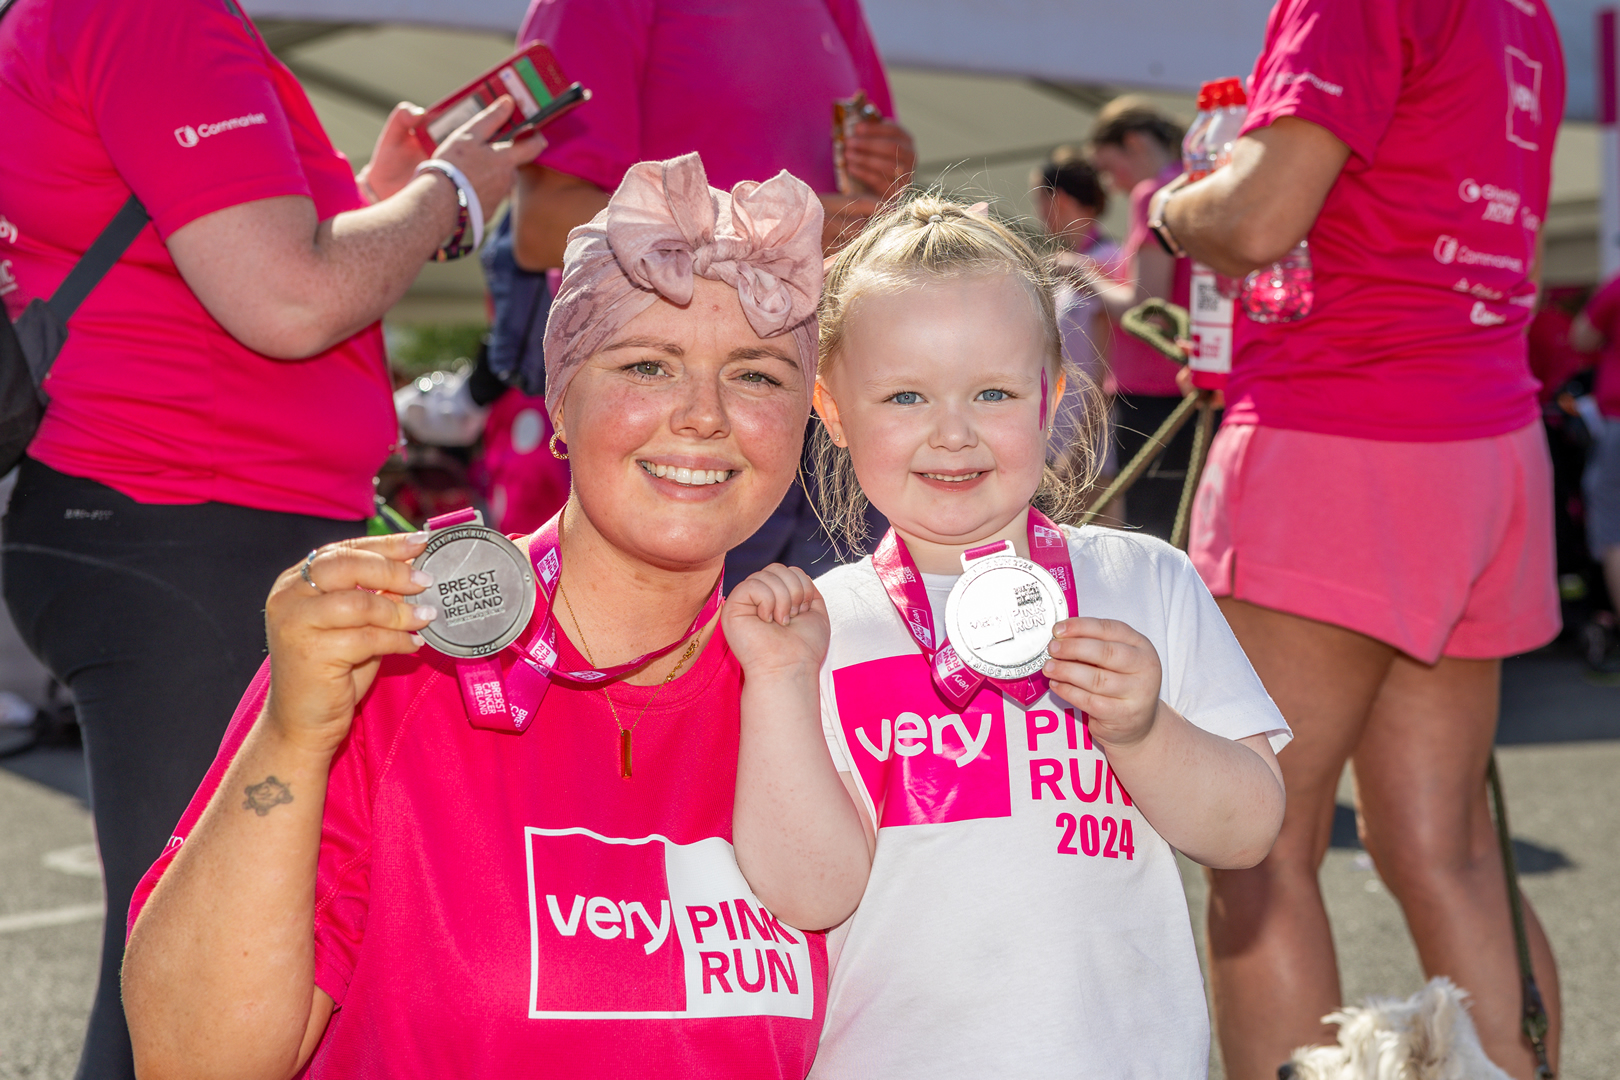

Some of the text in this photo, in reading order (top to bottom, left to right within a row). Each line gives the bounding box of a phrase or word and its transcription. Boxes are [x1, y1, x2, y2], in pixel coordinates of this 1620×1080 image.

[197, 112, 268, 138] Cornmarket
[425, 530, 490, 553] VERY PINK RUN
[442, 584, 500, 607] CANCER
[444, 596, 503, 619] IRELAND
[943, 648, 954, 672] PINK
[1014, 653, 1051, 676] DIFFER
[952, 674, 969, 690] very
[473, 683, 488, 715] IRELAND
[482, 683, 497, 714] CANCER
[855, 712, 992, 768] very
[1025, 708, 1097, 752] PI
[1055, 812, 1135, 861] 2024
[546, 894, 671, 955] very
[685, 898, 800, 946] PINK
[699, 948, 800, 995] RUN
